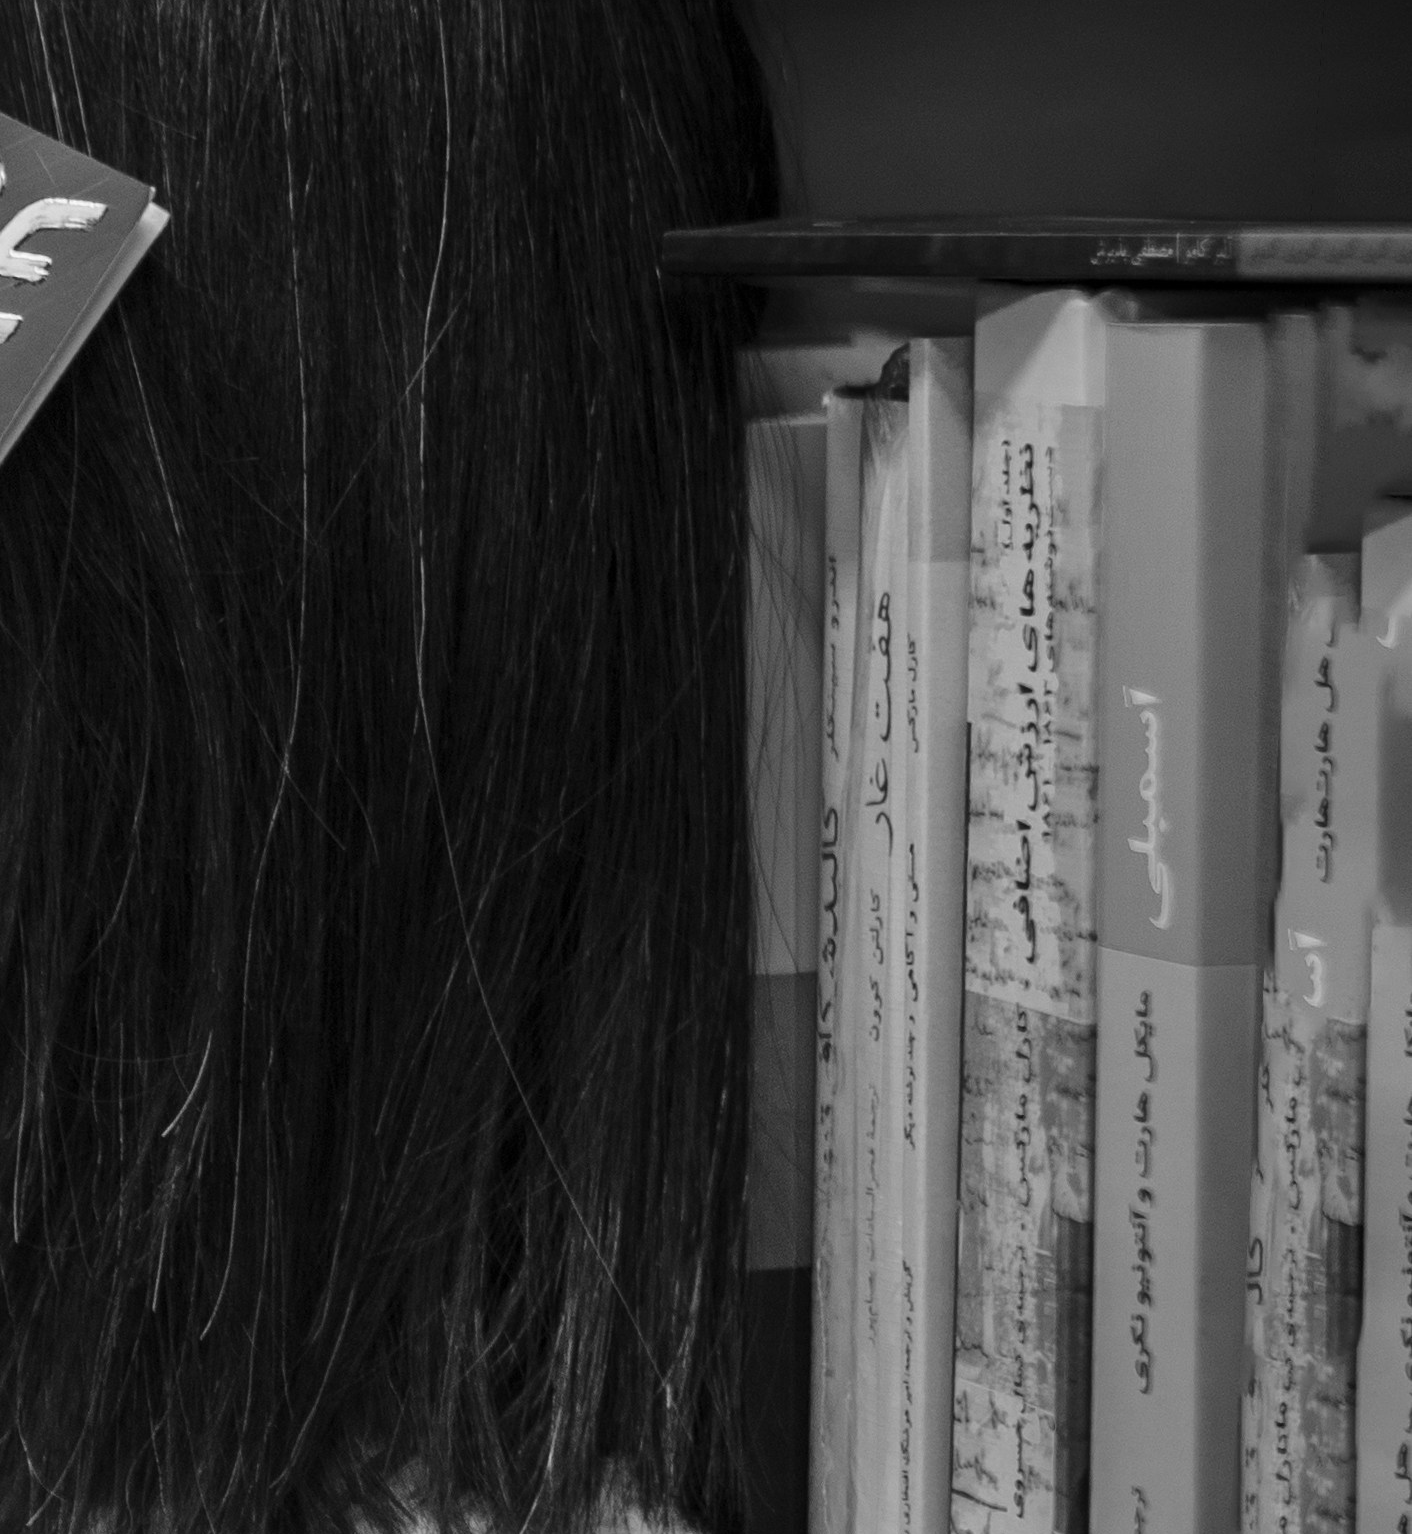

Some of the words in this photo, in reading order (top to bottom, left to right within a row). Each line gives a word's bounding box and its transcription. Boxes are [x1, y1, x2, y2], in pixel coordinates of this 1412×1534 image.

[1017, 441, 1042, 563] نظریه
[866, 591, 892, 744] هفت
[904, 632, 920, 684] کارل
[904, 687, 920, 755] مارکس
[1014, 681, 1040, 813] ارزش
[861, 756, 894, 860] غار
[1121, 684, 1175, 931] آسمبلی
[1010, 818, 1038, 966] اضافی
[1131, 988, 1159, 1086] مایکل
[1130, 1089, 1158, 1181] هارت
[1134, 1185, 1157, 1209] و
[1126, 1201, 1158, 1311] آنتونیو
[1127, 1311, 1157, 1397] نگری
